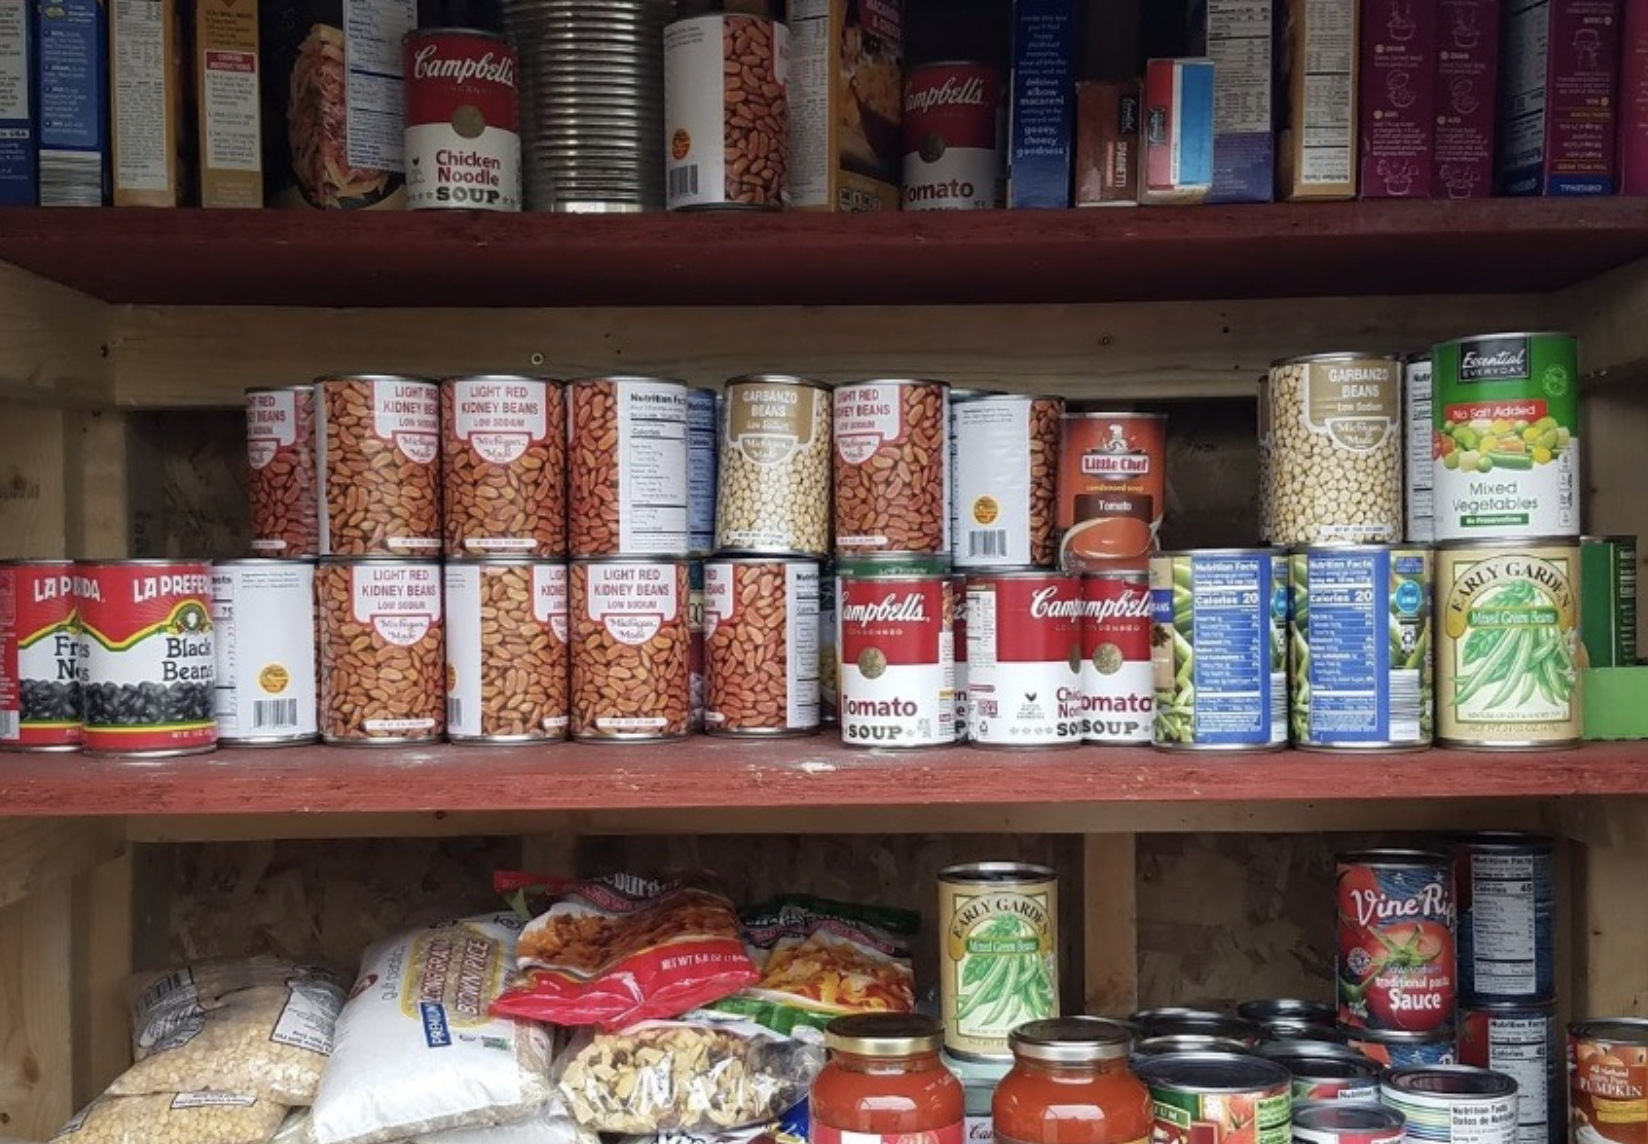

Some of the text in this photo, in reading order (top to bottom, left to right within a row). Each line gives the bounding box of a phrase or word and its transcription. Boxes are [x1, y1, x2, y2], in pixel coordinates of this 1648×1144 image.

[414, 44, 514, 87] Campbell's
[905, 77, 983, 113] ampbell's
[436, 150, 500, 170] Chicken
[438, 167, 500, 186] Noodle
[436, 187, 500, 204] SOUP
[903, 179, 974, 202] omato
[1462, 348, 1526, 368] Essential
[1328, 368, 1390, 382] GARBANZO
[1463, 366, 1525, 377] EVERYDAY
[395, 386, 424, 398] LIGHT
[470, 386, 528, 398] LIGHT RED
[742, 390, 798, 403] GARBANZO
[859, 389, 880, 400] RED
[1342, 386, 1380, 398] BEANS
[384, 401, 421, 414] KIDNEY
[462, 402, 538, 414] KIDNEY BEANS
[751, 405, 786, 418] BEANS
[857, 404, 890, 417] BEANS
[1453, 404, 1536, 420] No Salt Added
[1084, 457, 1148, 472] Little Chef
[1470, 481, 1518, 496] Mixed
[1099, 500, 1132, 512] Tomato
[1452, 497, 1538, 515] Vegetables
[374, 570, 429, 581] LIGHT RED
[604, 569, 661, 580] LIGHT RED
[34, 578, 56, 602] LA
[134, 578, 156, 604] LA
[362, 585, 436, 597] KIDNEY BEANS
[594, 584, 670, 596] KIDNEY BEANS
[1310, 590, 1372, 602] Calories 20
[1452, 564, 1500, 614] EARLY
[1505, 562, 1570, 608] GARDEN
[1196, 592, 1258, 605] Calories 20
[166, 638, 212, 658] Black
[162, 660, 214, 682] Beans
[1081, 692, 1152, 713] omato
[848, 724, 902, 740] SOUP
[1082, 719, 1140, 735] SOUP
[1474, 884, 1532, 894] Calories 45
[1350, 888, 1420, 926] Vine
[952, 899, 1048, 939] EARLY GARDEN
[1388, 988, 1442, 1010] Sauce
[424, 1004, 448, 1046] PREMIUM
[1580, 1077, 1643, 1097] PUMPKIN
